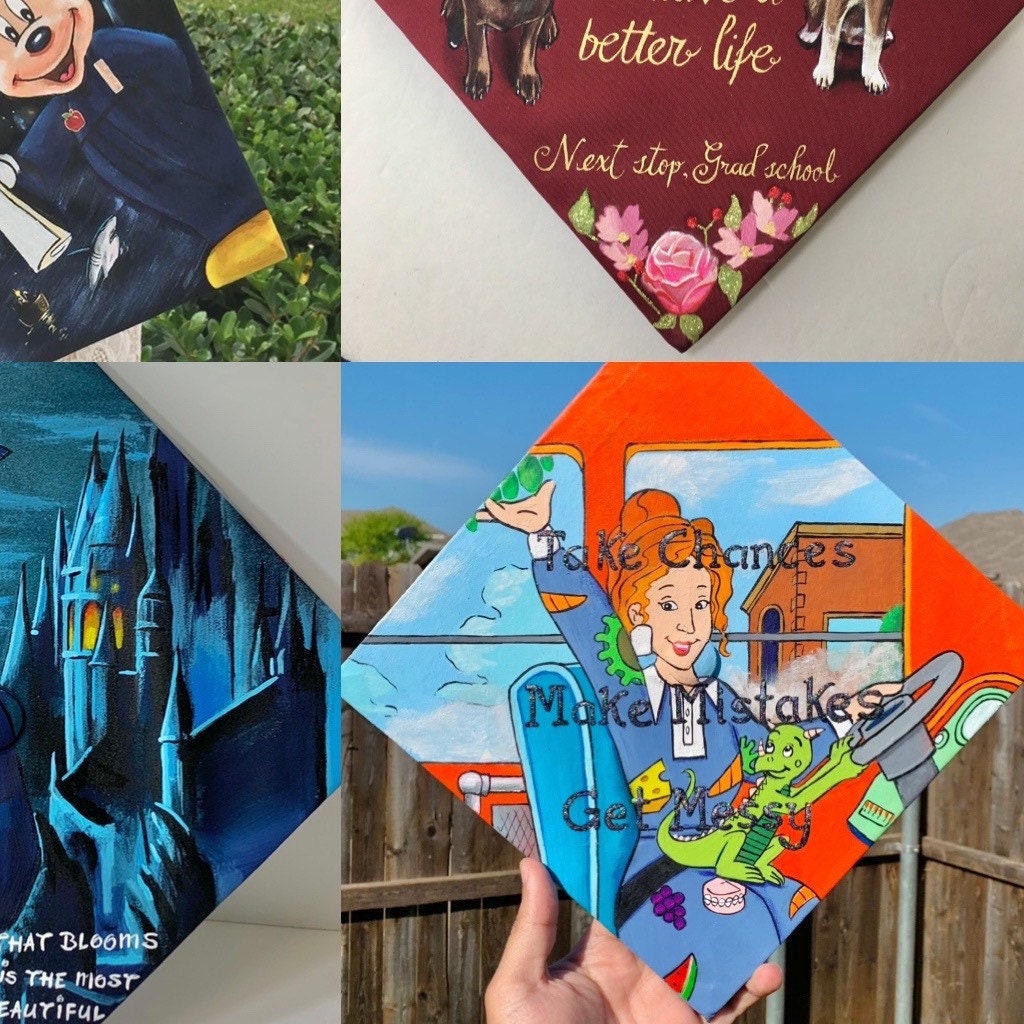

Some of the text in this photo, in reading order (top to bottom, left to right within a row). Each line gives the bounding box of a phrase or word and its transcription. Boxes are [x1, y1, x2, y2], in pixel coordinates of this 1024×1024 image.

[579, 14, 781, 86] better life
[534, 133, 629, 179] Next
[692, 140, 769, 184] Grad
[763, 145, 840, 183] school
[537, 529, 857, 571] Take Chances
[526, 677, 886, 726] Make Mistakes
[563, 786, 812, 851] Get Messy
[59, 930, 159, 951] BLOOMS
[25, 969, 67, 989] THE
